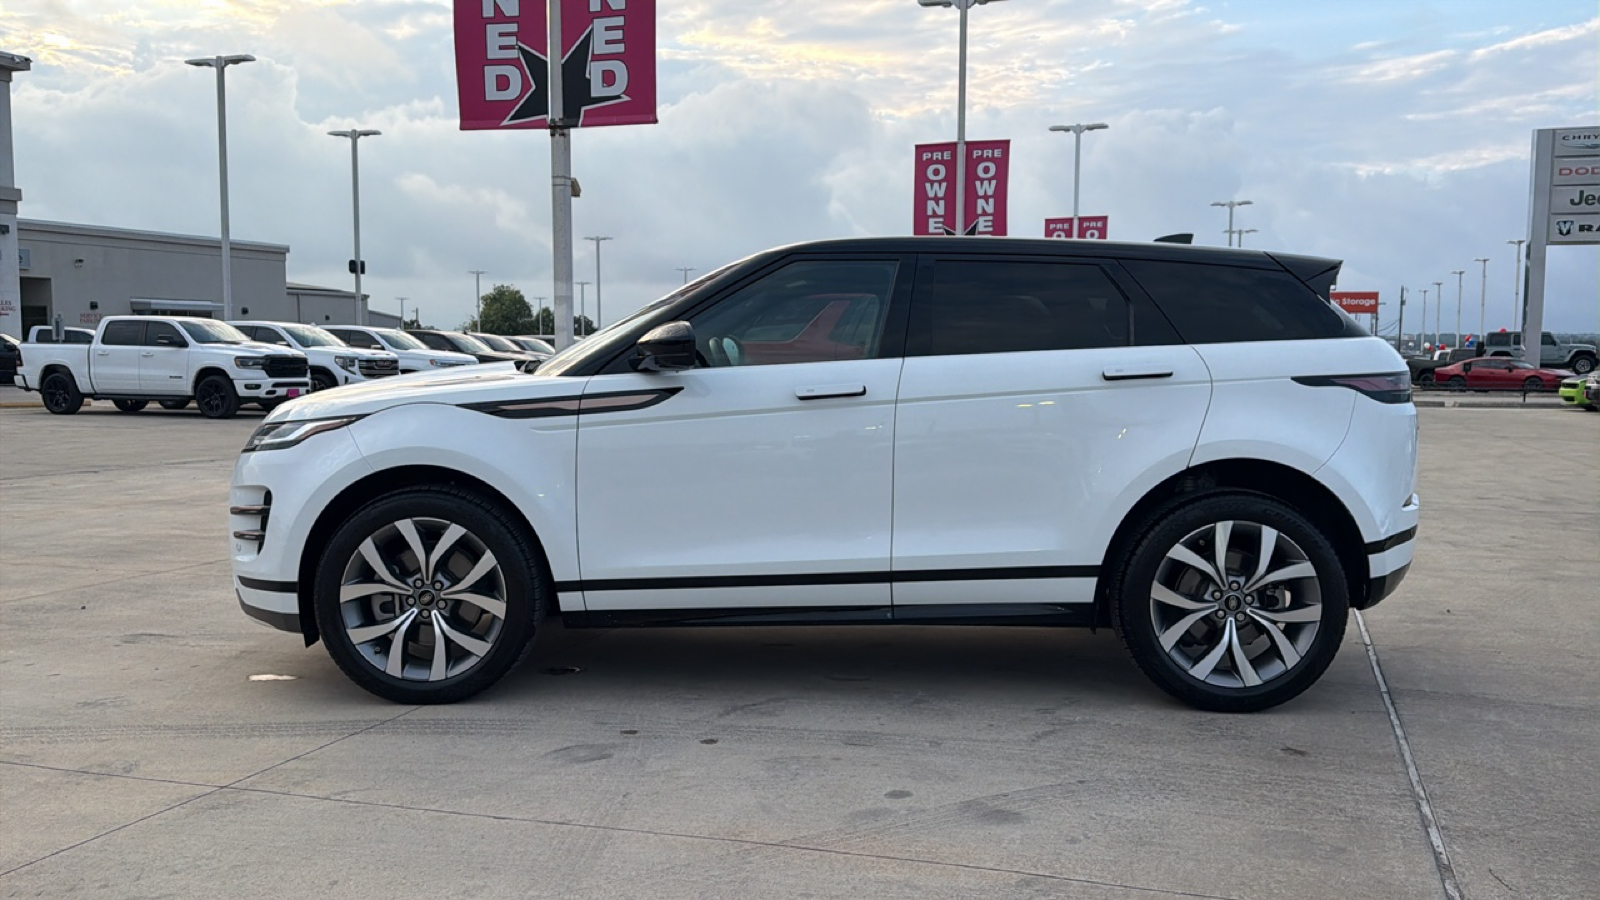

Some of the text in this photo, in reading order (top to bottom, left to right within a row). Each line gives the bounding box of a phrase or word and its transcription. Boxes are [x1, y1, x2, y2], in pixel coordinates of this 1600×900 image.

[922, 150, 952, 161] PRE
[973, 149, 1002, 159] PRE
[975, 161, 997, 236] OWNE
[1570, 190, 1600, 206] Je
[1342, 297, 1375, 306] Storage
